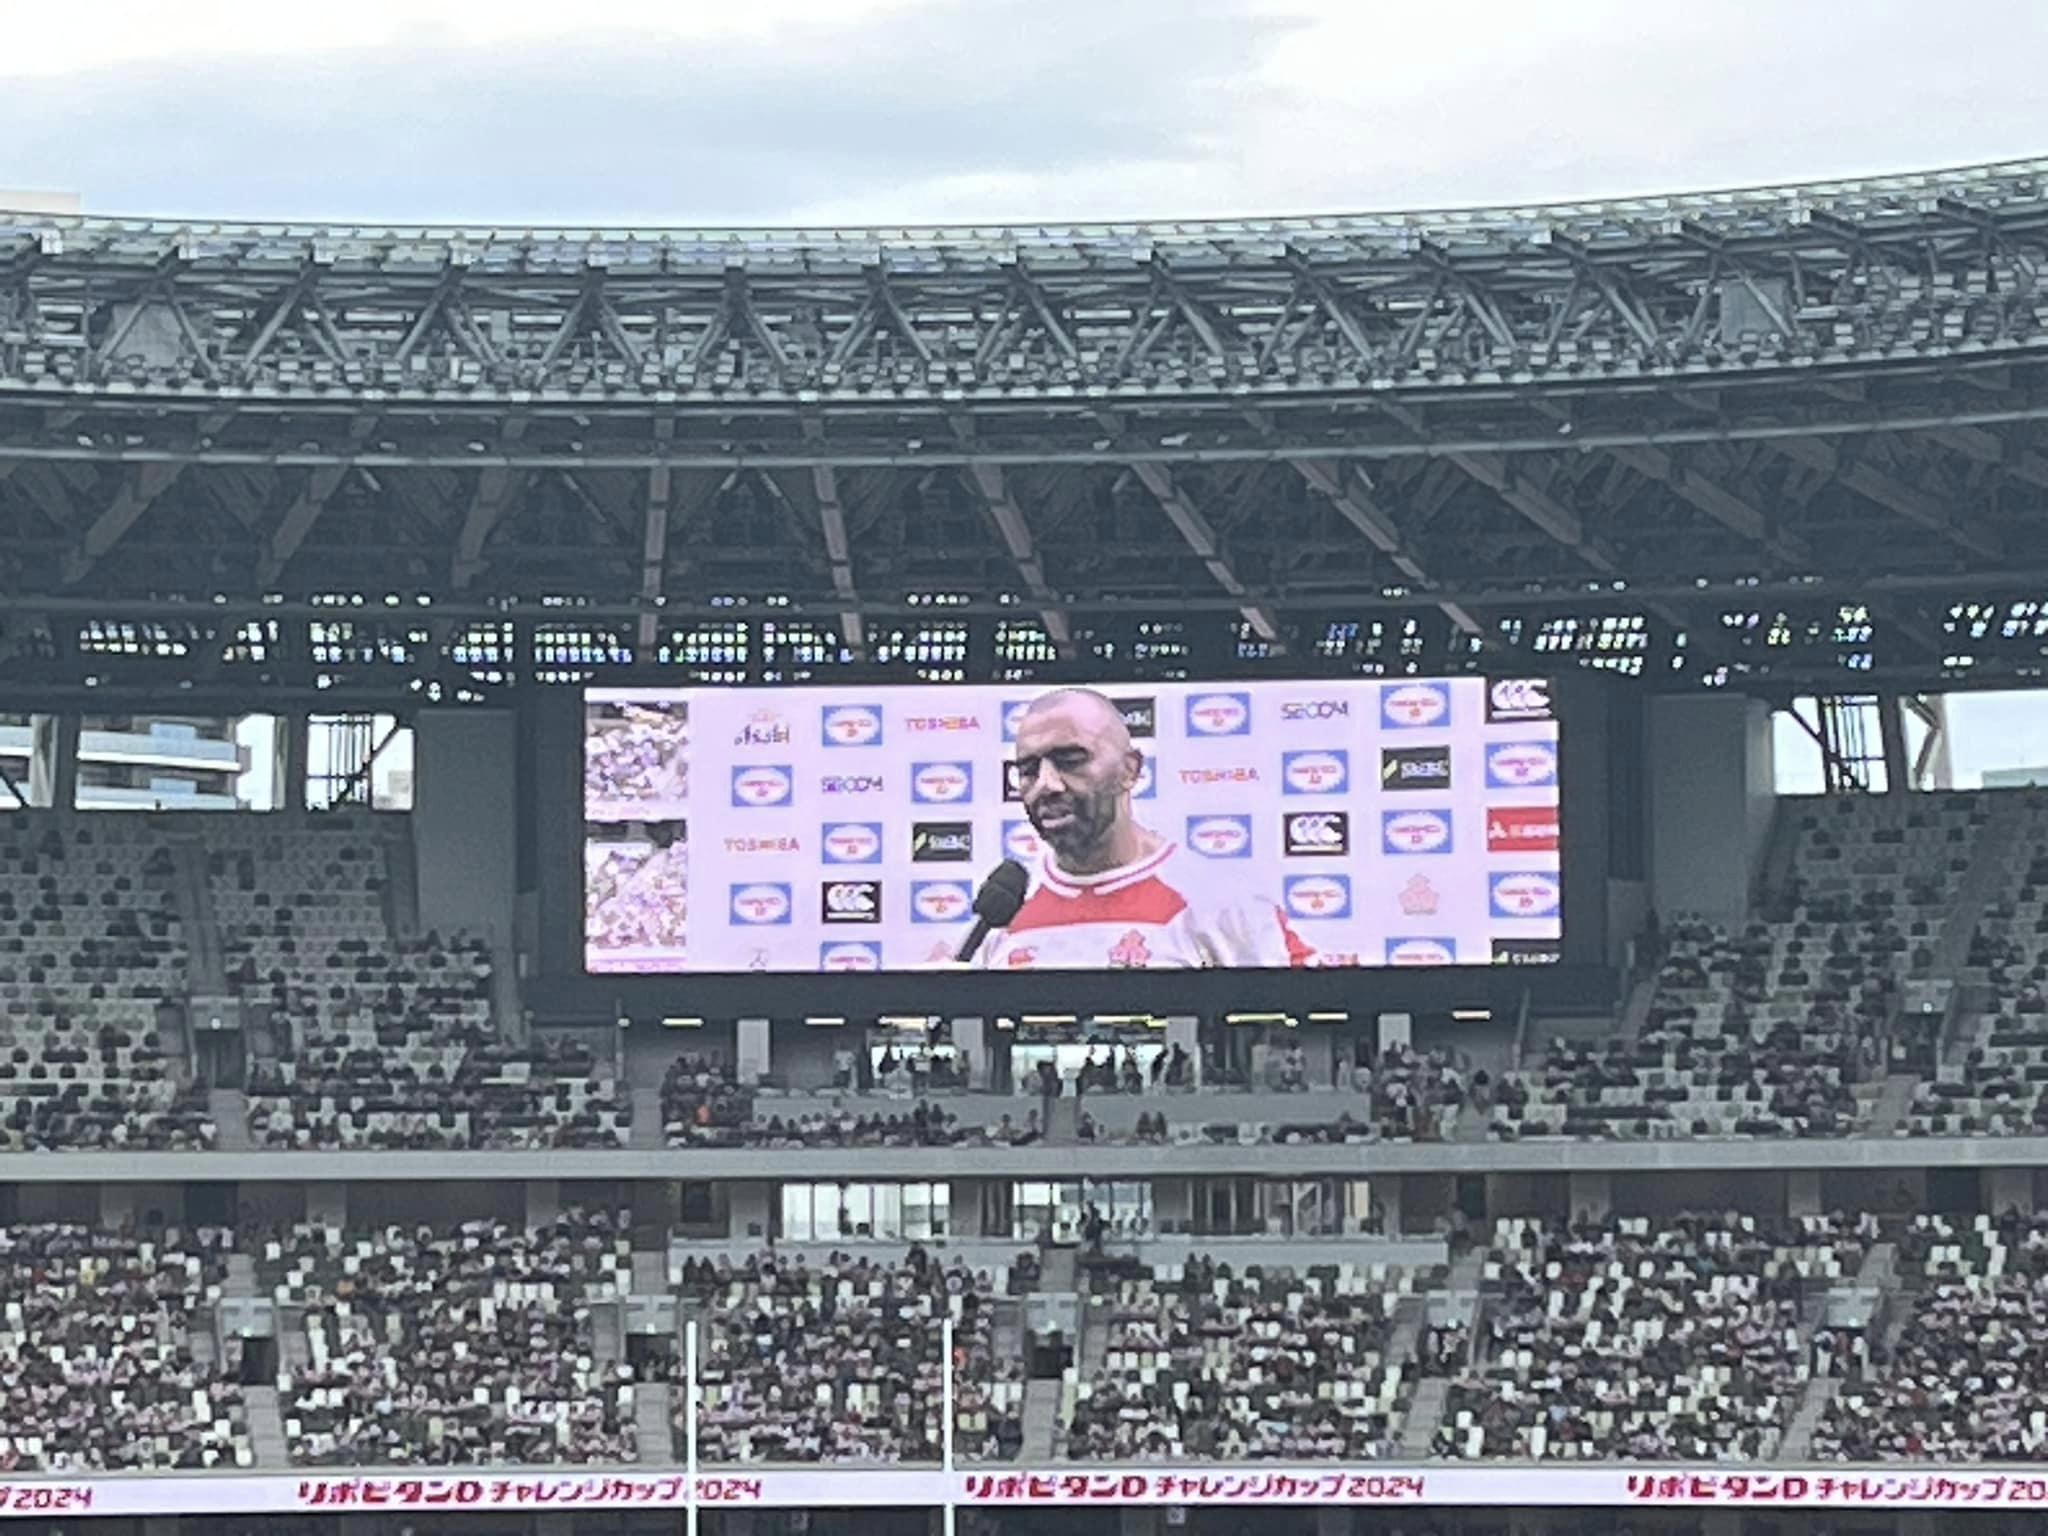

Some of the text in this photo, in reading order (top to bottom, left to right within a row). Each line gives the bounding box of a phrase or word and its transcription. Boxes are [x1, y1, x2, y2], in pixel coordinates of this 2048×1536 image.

[1281, 700, 1349, 720] SECOM
[903, 715, 980, 732] TOSHIBA
[1178, 767, 1261, 785] TOSHIBA
[723, 836, 801, 853] TOSHIBA
[299, 1479, 483, 1504] リポビタンD
[966, 1473, 1147, 1499] リポビタンD
[1627, 1474, 2048, 1501] リポビタンD チャレンジカップ20
